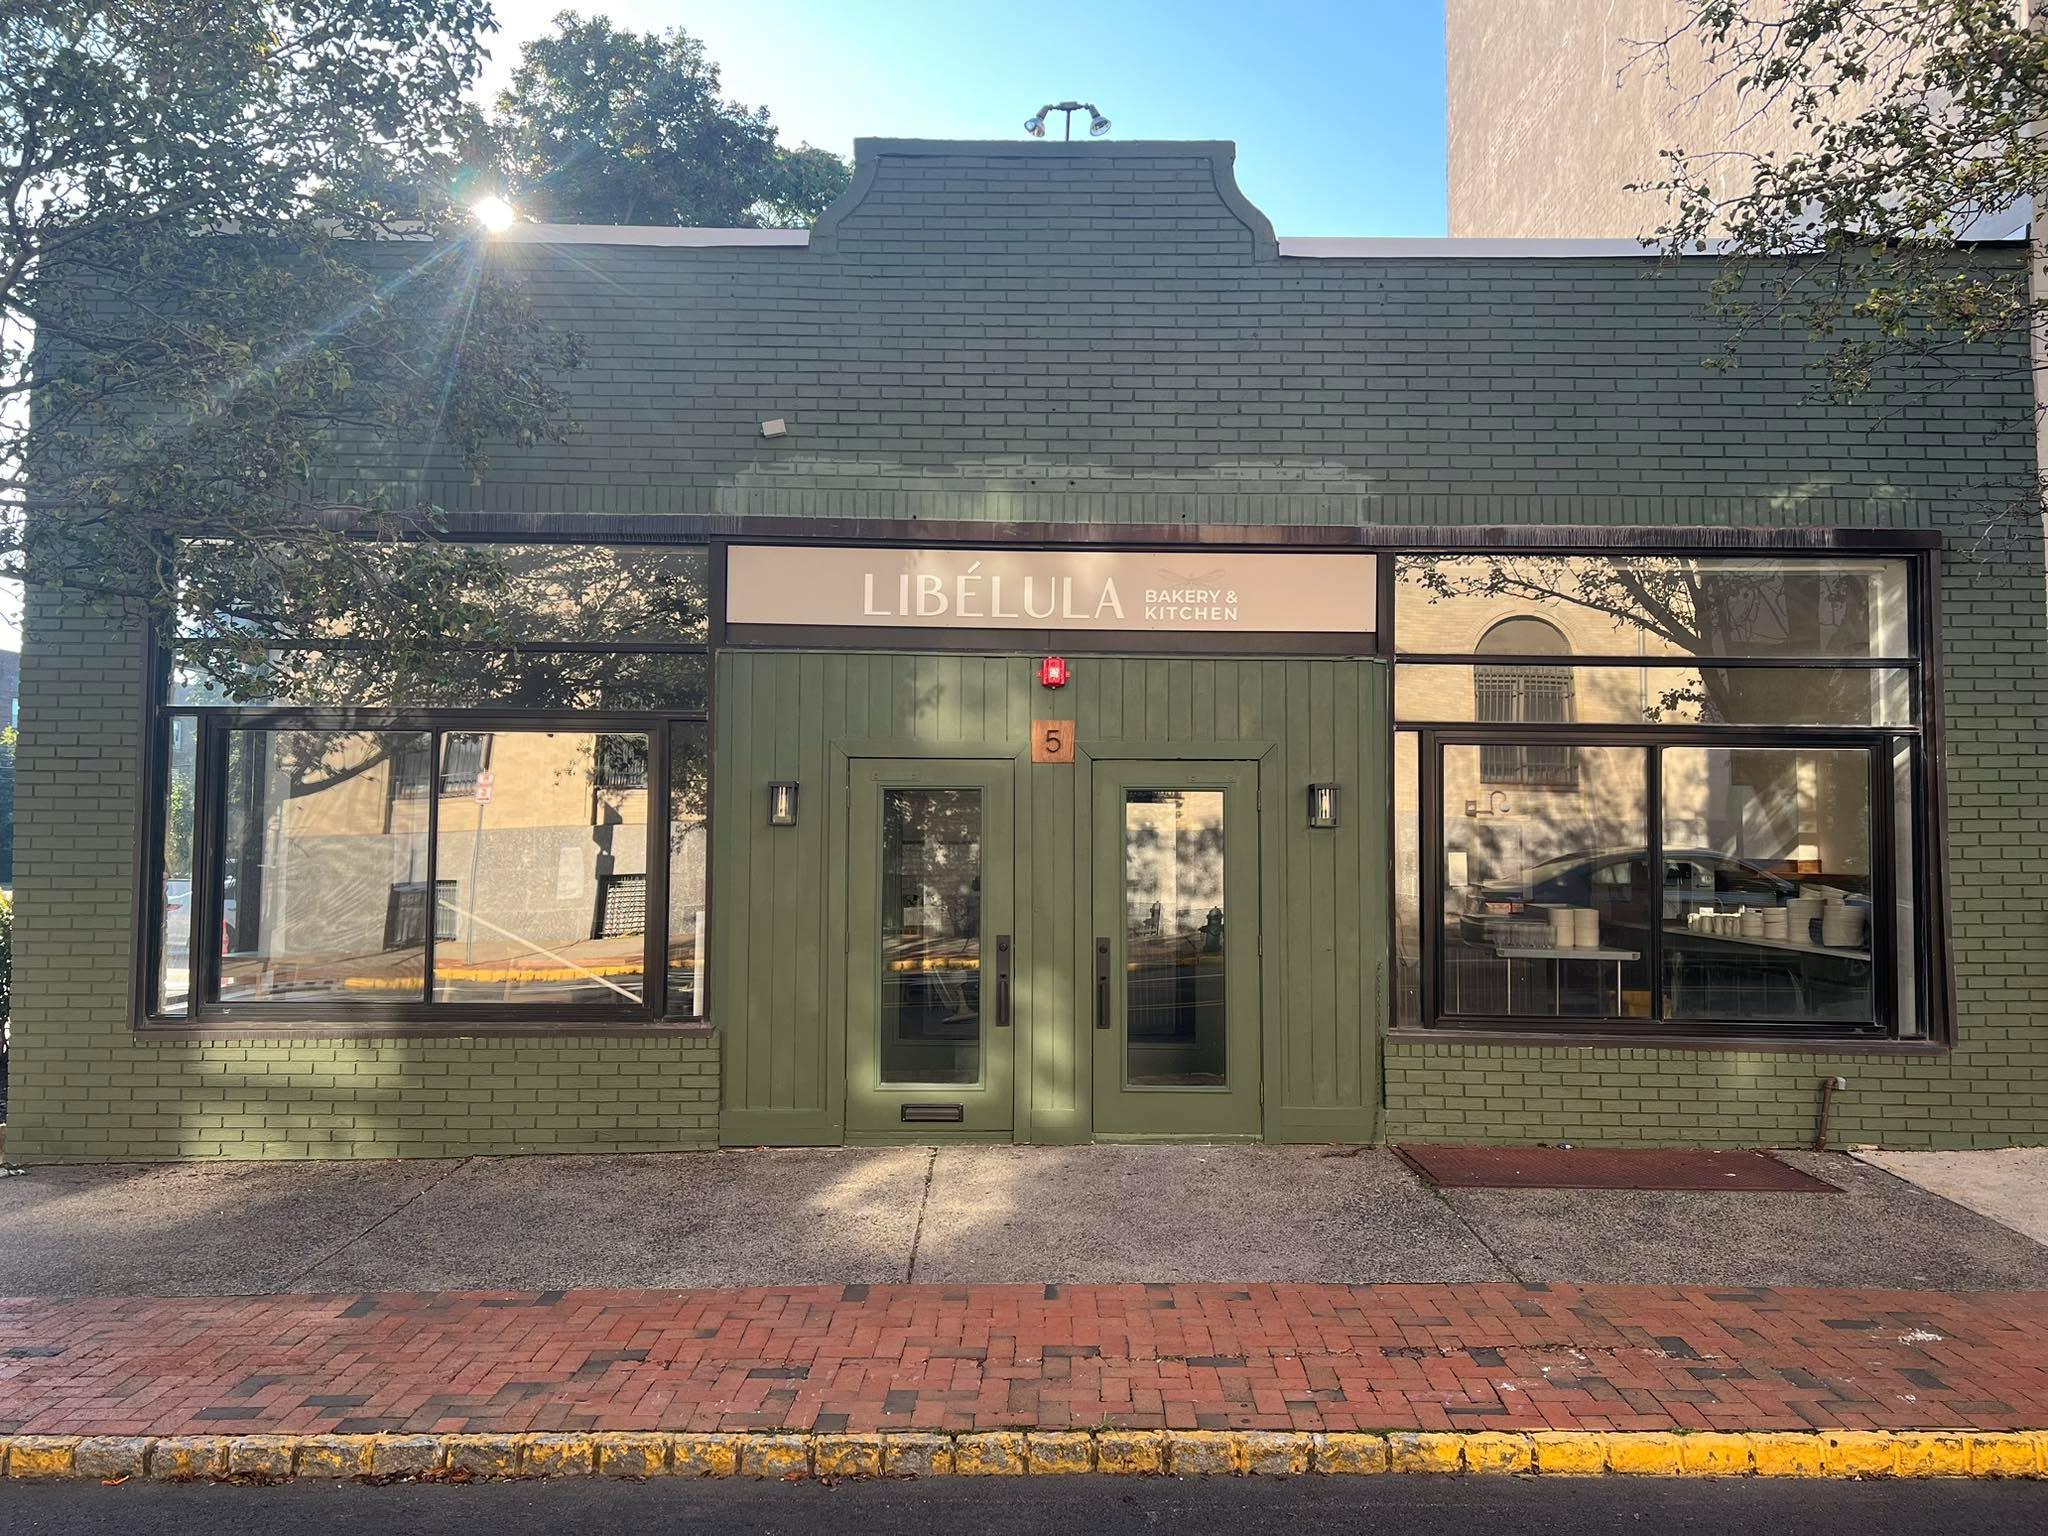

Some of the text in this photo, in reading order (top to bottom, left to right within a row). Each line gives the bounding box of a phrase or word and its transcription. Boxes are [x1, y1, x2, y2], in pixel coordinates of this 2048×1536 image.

[863, 560, 1125, 619] LIBÉLULA
[1145, 589, 1238, 604] BAKERY &
[1145, 606, 1238, 621] KITCHEN
[1046, 729, 1061, 753] 5
